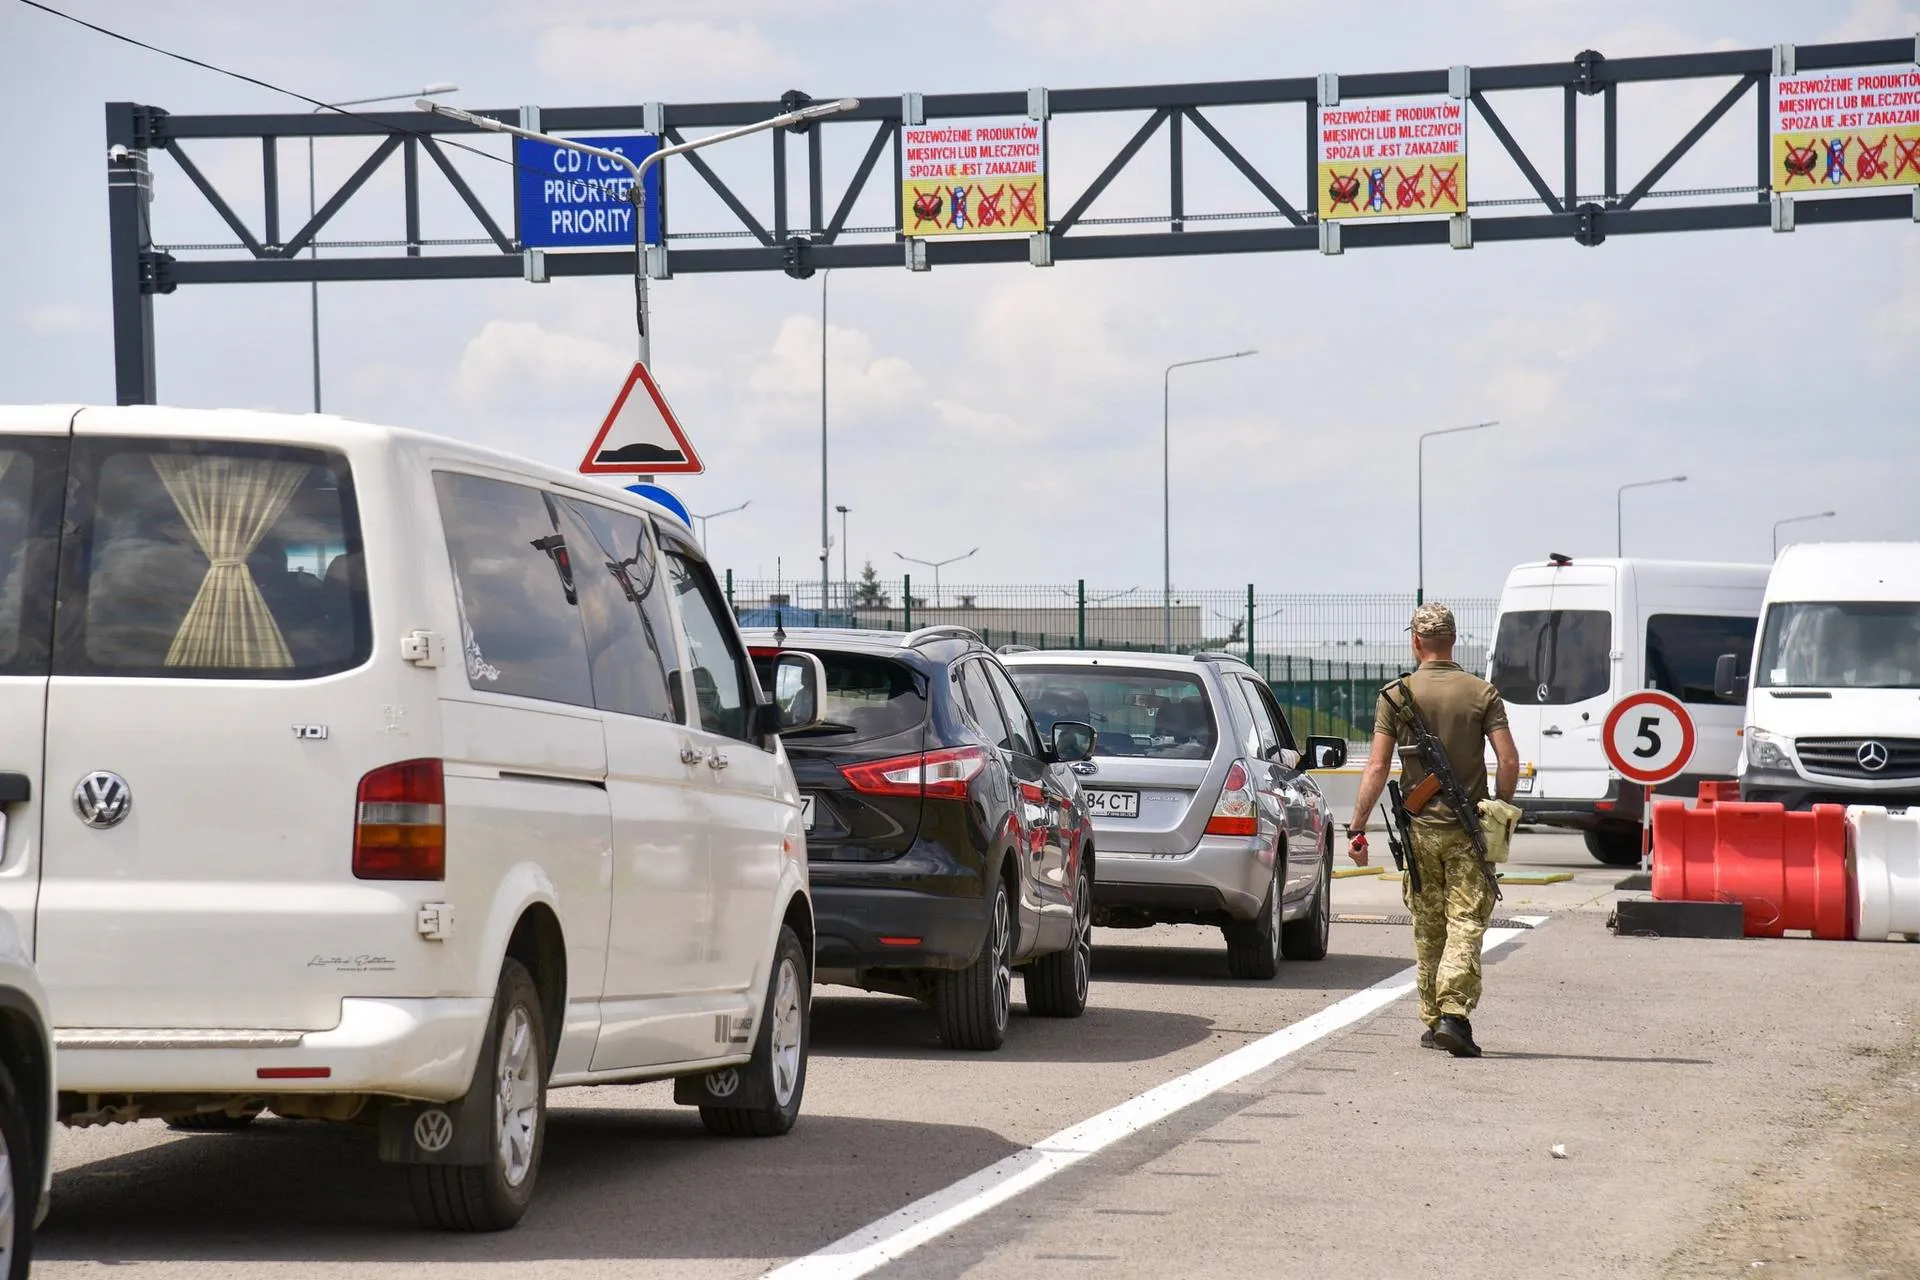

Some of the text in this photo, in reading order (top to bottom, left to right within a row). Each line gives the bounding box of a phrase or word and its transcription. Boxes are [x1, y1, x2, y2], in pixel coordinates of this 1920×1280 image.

[1779, 75, 1853, 95] PRZEWOŻENIE
[1323, 102, 1460, 125] PRZEWOŻENIE PRODUKTÓW
[1779, 97, 1834, 115] MIĘSNYCH
[1837, 96, 1858, 110] LUB
[1782, 117, 1818, 131] SPOZA
[1822, 115, 1834, 128] UE
[1837, 113, 1863, 127] JEST
[906, 123, 1038, 144] PRZEWOŻENIE PRODUKTÓW
[1323, 123, 1462, 145] MIĘSNYCH LUB MLECZNYCH
[907, 143, 1040, 162] MIĘSNYCH LUB MLECZNYCH
[1326, 140, 1459, 159] SPOZA UE JEST ZAKAZANE
[554, 149, 581, 172] CD
[909, 160, 1037, 177] SPOZA UE JEST ZAKAZANE
[551, 208, 631, 234] PRIORITY
[291, 724, 328, 740] TDI
[1632, 716, 1662, 758] 5
[1083, 792, 1105, 809] 84
[1109, 794, 1134, 810] CT
